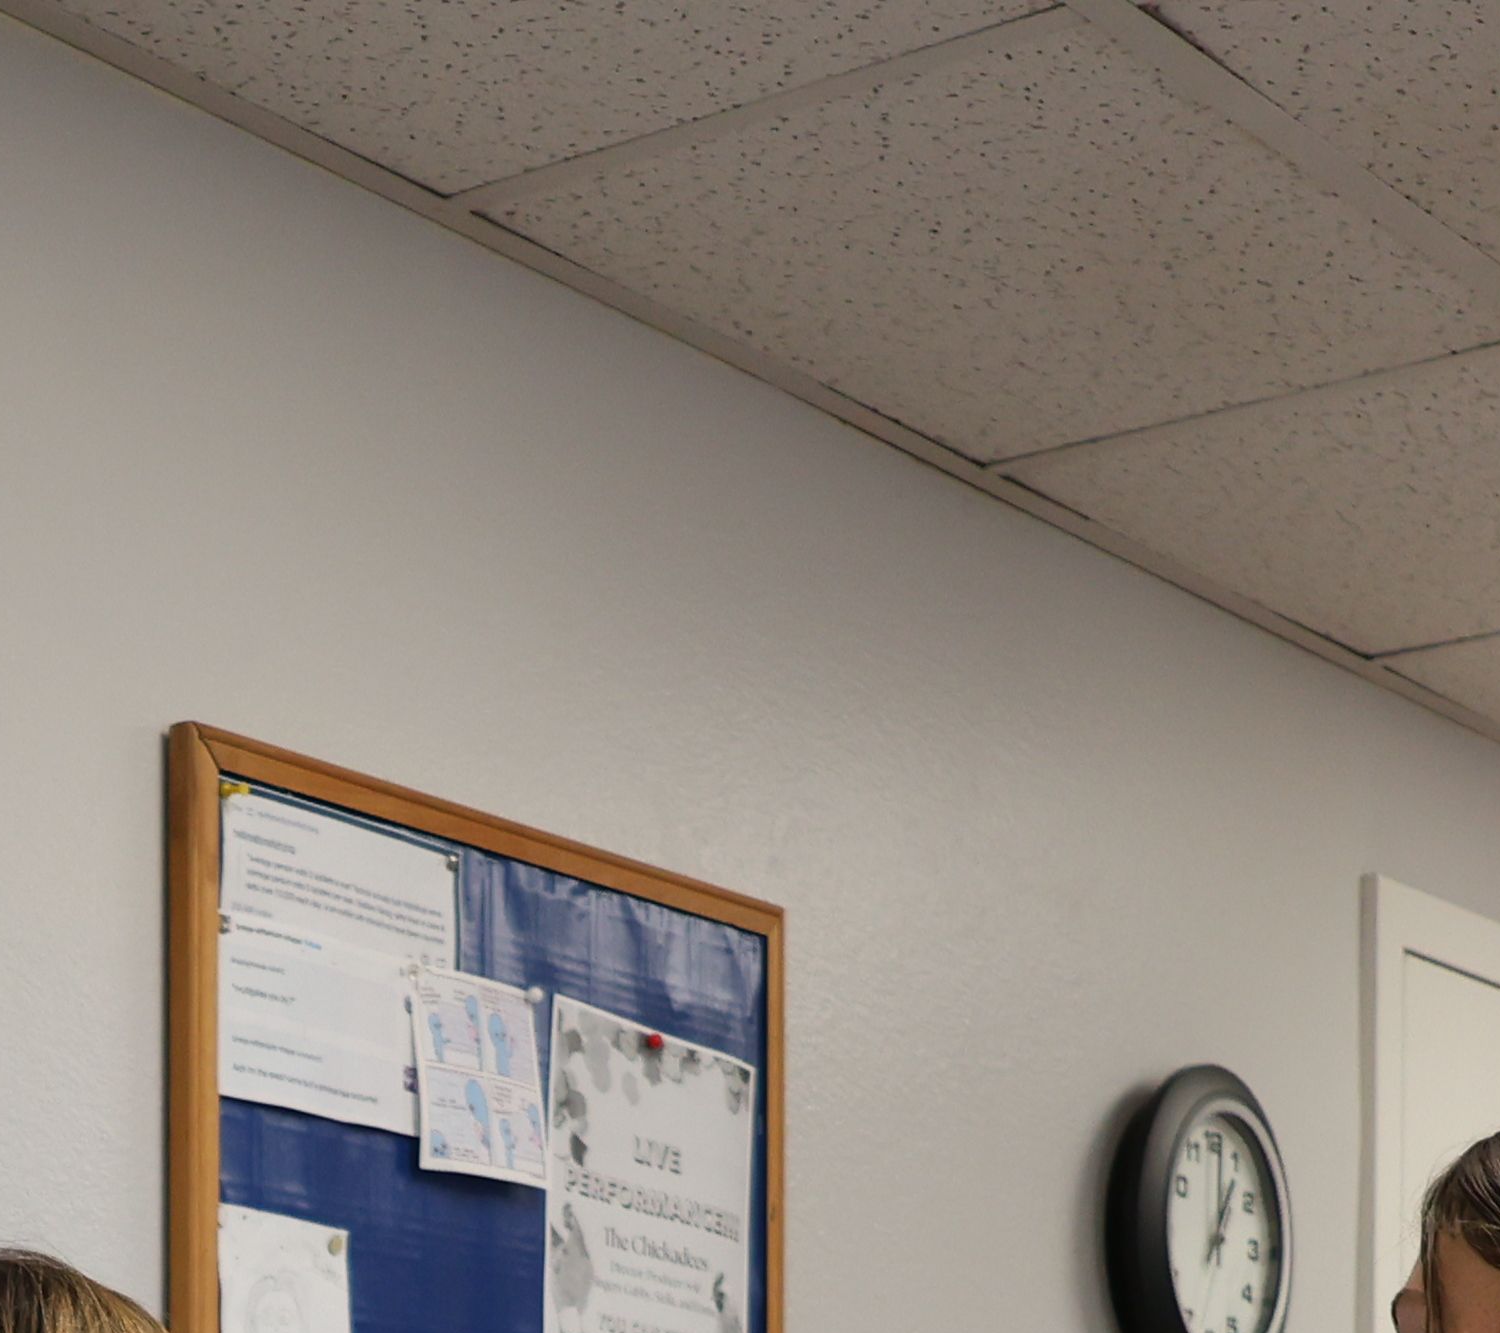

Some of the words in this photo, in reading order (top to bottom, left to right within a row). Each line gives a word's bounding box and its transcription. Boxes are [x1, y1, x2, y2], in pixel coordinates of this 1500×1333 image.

[633, 1134, 683, 1175] LIVE
[1242, 1190, 1255, 1215] 2
[604, 1226, 629, 1251] The
[1247, 1238, 1260, 1262] 3
[1241, 1283, 1254, 1304] 4
